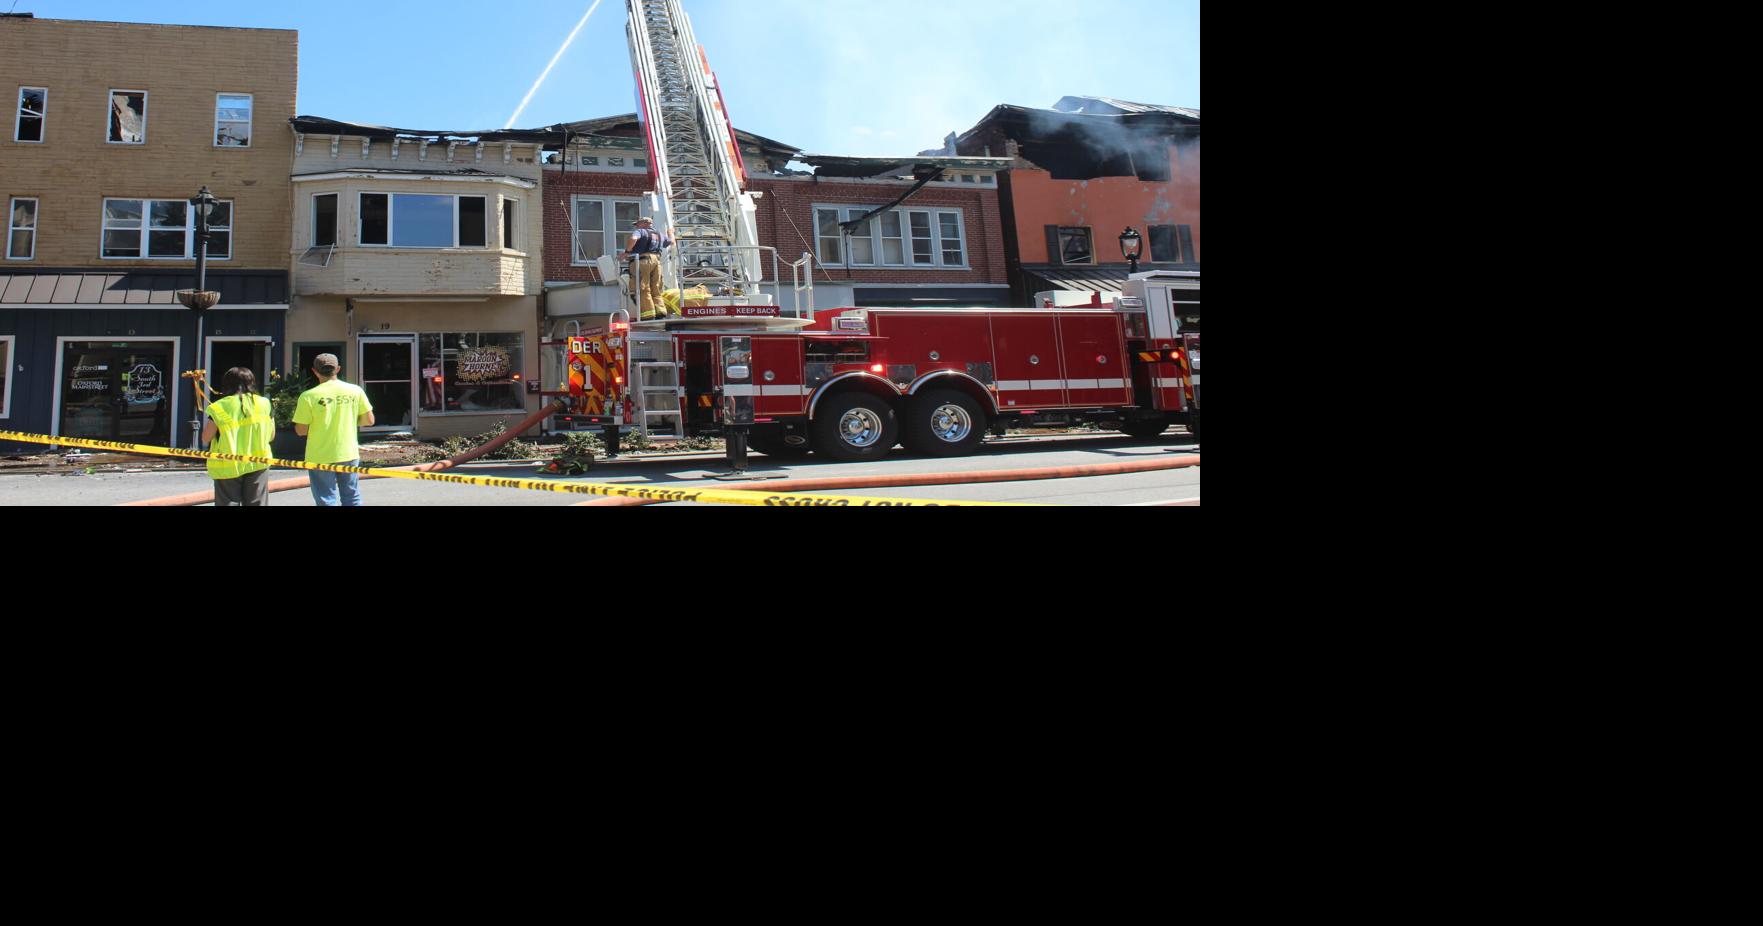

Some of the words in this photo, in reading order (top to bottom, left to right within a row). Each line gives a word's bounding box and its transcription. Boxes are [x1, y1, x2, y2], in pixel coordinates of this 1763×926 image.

[687, 307, 727, 315] ENGINES
[736, 307, 755, 315] KEEP
[757, 307, 776, 315] BACK
[380, 322, 390, 330] 19
[572, 340, 601, 354] DER
[464, 355, 498, 363] MAROON
[138, 366, 151, 374] 13
[132, 374, 156, 382] South
[583, 365, 593, 390] 1
